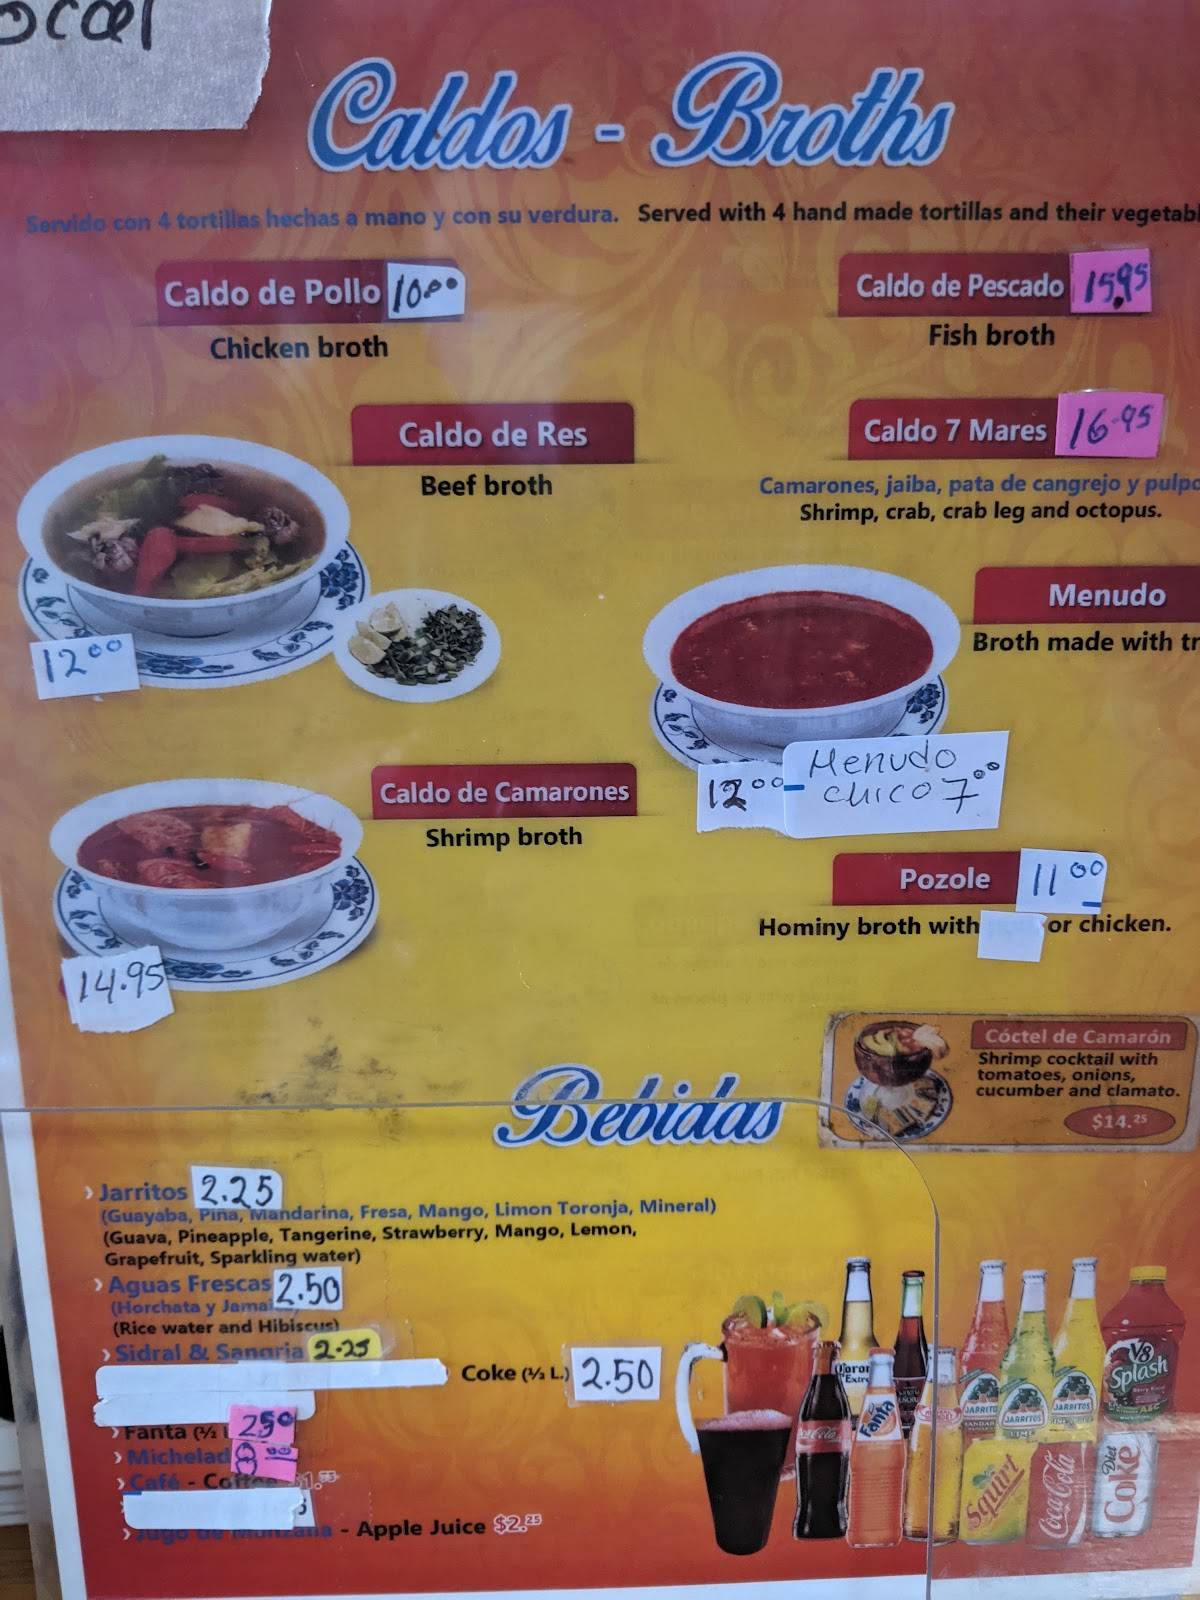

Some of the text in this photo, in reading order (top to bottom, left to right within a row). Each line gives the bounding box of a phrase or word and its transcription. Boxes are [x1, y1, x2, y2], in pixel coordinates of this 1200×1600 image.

[307, 50, 955, 172] Caldos Broths
[26, 206, 619, 234] Servido con 4 tortillas hechas a mano y con su verdura.
[638, 203, 711, 223] Served
[718, 202, 766, 222] with
[772, 203, 786, 222] 4
[793, 202, 847, 222] hand
[853, 202, 913, 222] made
[920, 202, 1002, 221] tortillas
[1010, 202, 1049, 221] and
[1055, 201, 1105, 222] their
[165, 278, 380, 308] Caldo de Pollo
[857, 272, 1065, 298] Caldo de Pescado
[929, 323, 1056, 346] Fish broth
[210, 336, 389, 361] Chicken broth
[400, 422, 589, 448] Caldo de Res
[864, 419, 1048, 443] Caldo 7 Mares
[421, 474, 553, 496] Beef broth
[759, 474, 880, 498] Camarones,
[884, 474, 943, 498] jaiba,
[948, 476, 996, 498] pata
[1000, 474, 1027, 492] de
[1031, 474, 1121, 497] cangrejo
[1127, 478, 1139, 496] y
[800, 501, 1162, 525] Shrimp, crab, crab leg and octopus.
[1049, 582, 1166, 608] Menudo
[973, 632, 1039, 652] Broth
[1048, 632, 1114, 652] made
[1122, 631, 1172, 651] with
[380, 779, 630, 804] Caldo de Camarones
[426, 826, 583, 852] Shrimp broth
[900, 868, 991, 890] Pozole
[759, 914, 1172, 940] Hominy broth with or chicken.
[78, 962, 166, 1006] 14.95
[985, 1027, 1172, 1046] Cóctel de Camarón
[978, 1051, 1158, 1068] Shrimp cocktail with
[977, 1068, 1136, 1084] tomatoes, onions,
[976, 1083, 1181, 1098] cucumber and clamato.
[494, 1062, 784, 1148] Bebidas
[99, 1183, 187, 1201] Jarritos
[200, 1174, 274, 1209] 2.25
[102, 1207, 192, 1226] (Guayaba,
[250, 1204, 353, 1222] Mandarina,
[361, 1204, 412, 1221] Fresa,
[419, 1203, 489, 1221] Mango,
[558, 1200, 634, 1218] Toronja,
[640, 1197, 717, 1215] Mineral)
[104, 1221, 637, 1247] (Guava, Pineapple, Tangerine, Strawberry, Mango, Lemon,
[106, 1248, 361, 1269] Grapefruit, Sparkling water)
[108, 1274, 271, 1298] Aguas Frescas
[276, 1272, 340, 1306] 2.50
[112, 1299, 215, 1317] (Horchata y
[113, 1317, 339, 1338] (Rice water and Hibiscus)
[116, 1343, 181, 1362] Sidral
[189, 1344, 208, 1361] &
[1130, 1340, 1152, 1363] V8
[462, 1364, 516, 1382] Coke
[582, 1356, 654, 1394] 2.50
[1110, 1355, 1169, 1393] Splash
[860, 1401, 895, 1438] Fanta
[124, 1424, 187, 1440] Fanta
[1102, 1446, 1117, 1475] Diet
[967, 1453, 1019, 1529] Squirt
[1104, 1446, 1141, 1523] Coke
[357, 1520, 423, 1542] Apple
[430, 1518, 486, 1537] Juice
[494, 1514, 542, 1535] $2.25
